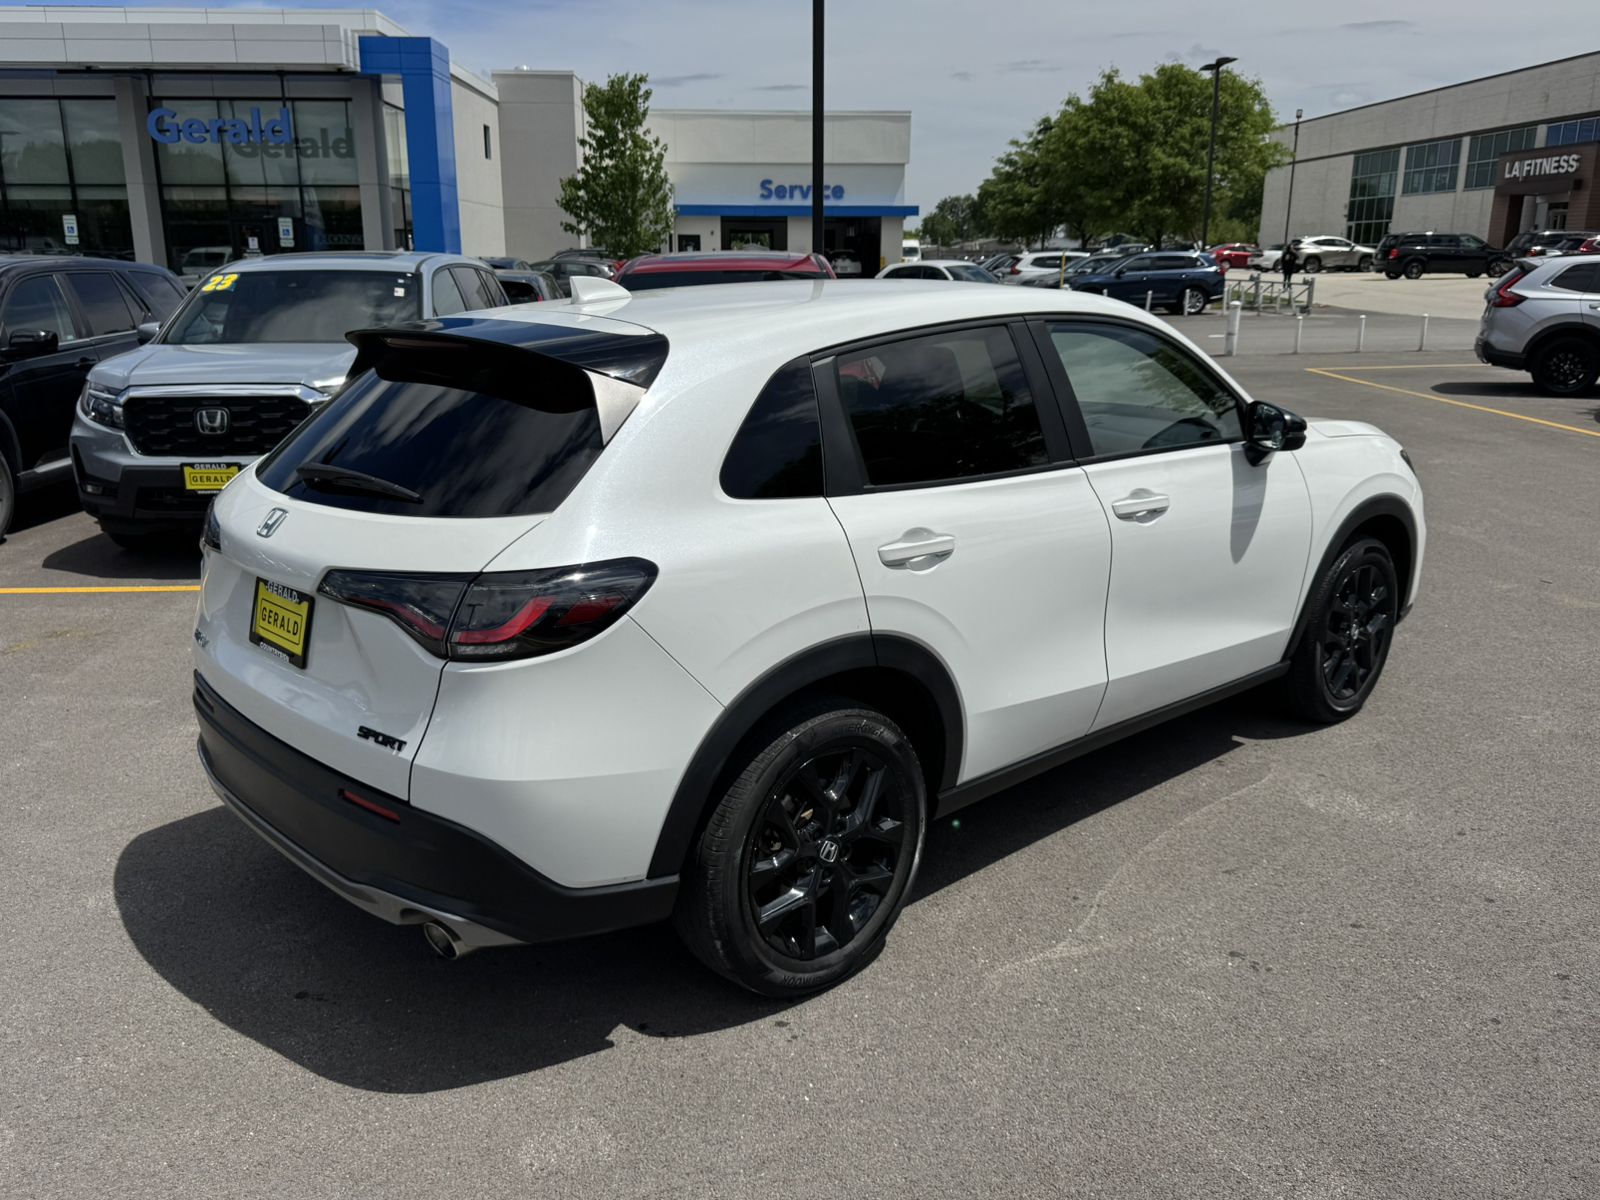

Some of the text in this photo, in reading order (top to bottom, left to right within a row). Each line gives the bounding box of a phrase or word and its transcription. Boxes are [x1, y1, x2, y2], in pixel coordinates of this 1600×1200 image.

[147, 107, 292, 144] Gerald
[1504, 154, 1579, 178] LA FITNESS
[759, 179, 845, 200] Servce
[318, 235, 364, 243] HOND
[267, 581, 298, 603] GERALD
[261, 606, 299, 636] GERALD
[357, 725, 407, 752] SPORT
